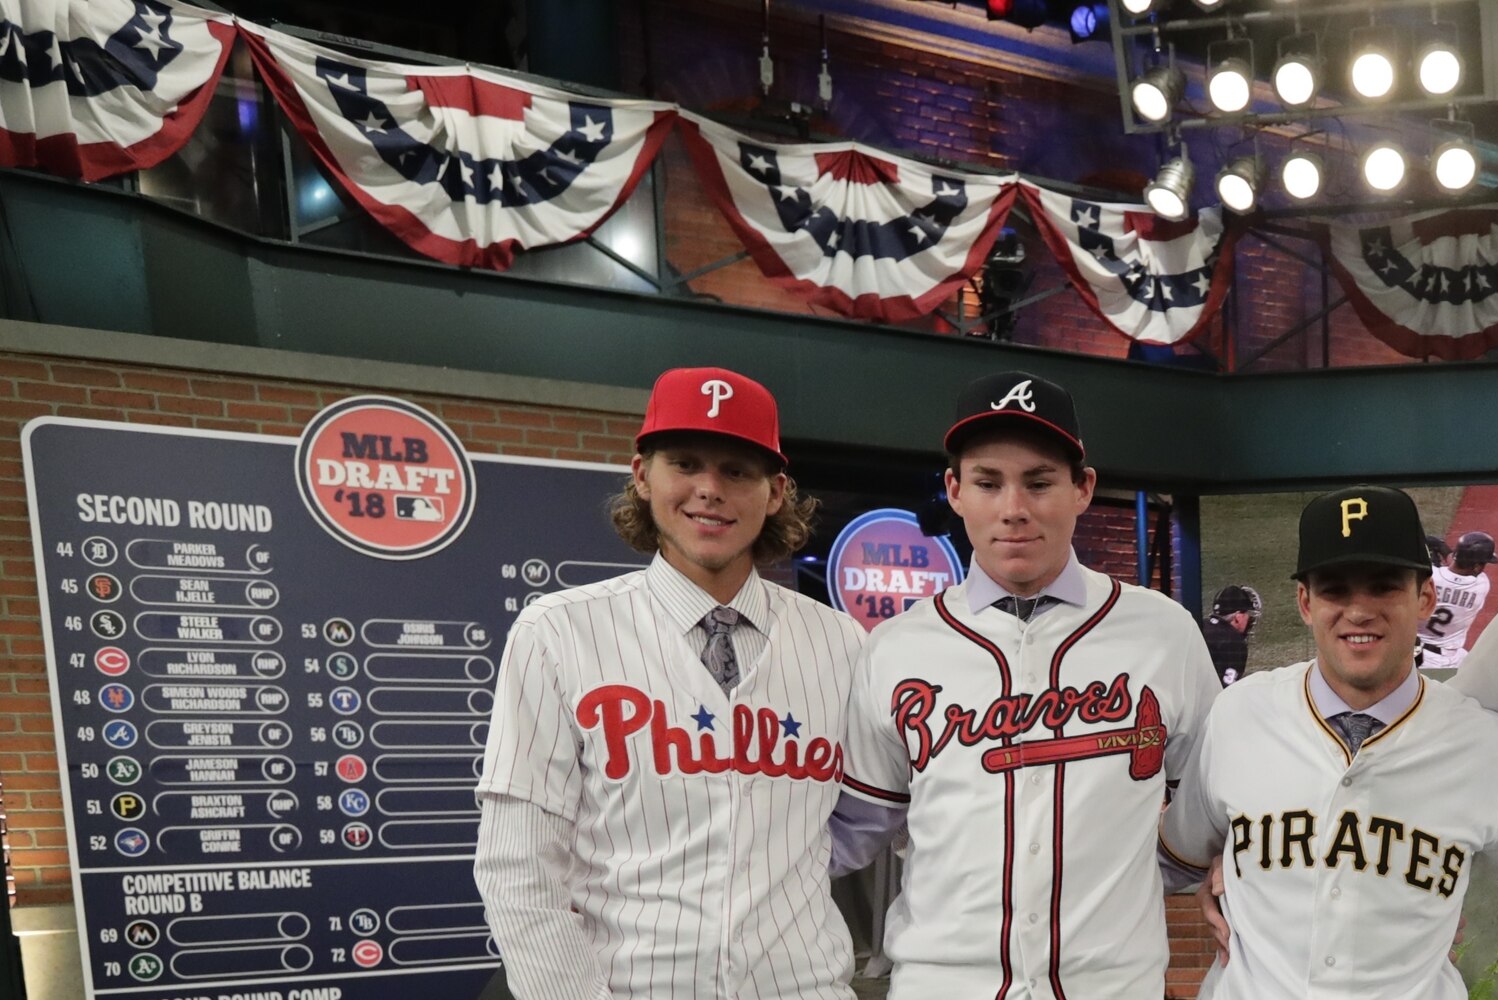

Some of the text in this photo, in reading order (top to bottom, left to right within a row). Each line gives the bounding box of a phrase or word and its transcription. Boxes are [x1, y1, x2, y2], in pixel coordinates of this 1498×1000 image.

[700, 378, 734, 419] P
[990, 379, 1036, 413] A
[340, 431, 429, 464] MLB
[316, 458, 456, 495] DRAFT
[77, 493, 272, 532] SECOND ROUND
[1340, 497, 1369, 538] P
[56, 542, 73, 557] 44
[173, 543, 216, 555] PARKER
[861, 542, 929, 568] MLB
[167, 555, 224, 568] MEADOWS
[501, 564, 517, 579] 60
[61, 579, 78, 593] 45
[179, 580, 209, 591] SEAN
[843, 567, 949, 595] DRAFT
[176, 591, 215, 603] HJELLE
[251, 588, 273, 599] RHP
[505, 597, 518, 612] 61
[65, 617, 82, 631] 46
[180, 617, 219, 628] STEELE
[1425, 608, 1454, 637] 2
[177, 628, 223, 640] WALKER
[302, 624, 316, 638] 53
[70, 654, 85, 667] 47
[187, 652, 215, 663] LYON
[167, 663, 237, 675] RICHARDSON
[305, 659, 319, 673] 54
[74, 690, 90, 705] 48
[162, 687, 247, 699] SIMEON WOODS
[308, 693, 323, 707] 55
[171, 699, 241, 710] RICHARDSON
[77, 727, 94, 741] 49
[183, 723, 233, 734] GREYSON
[311, 728, 326, 741] 56
[575, 684, 844, 783] Phillies
[891, 672, 1133, 783] Braves
[187, 735, 232, 746] JENISTA
[81, 764, 99, 778] 50
[314, 762, 328, 776] 57
[87, 800, 102, 814] 51
[191, 795, 242, 806] BRAXTON
[317, 796, 332, 810] 58
[191, 807, 245, 818] ASHCRAFT
[90, 836, 107, 850] 52
[320, 830, 335, 843] 59
[1230, 809, 1466, 899] PIRATES
[123, 868, 312, 894] COMPETITIVE BALANCE
[125, 894, 203, 915] ROUND B
[329, 916, 342, 931] 71
[100, 929, 118, 942] 69
[331, 948, 345, 962] 72
[104, 962, 121, 976] 70
